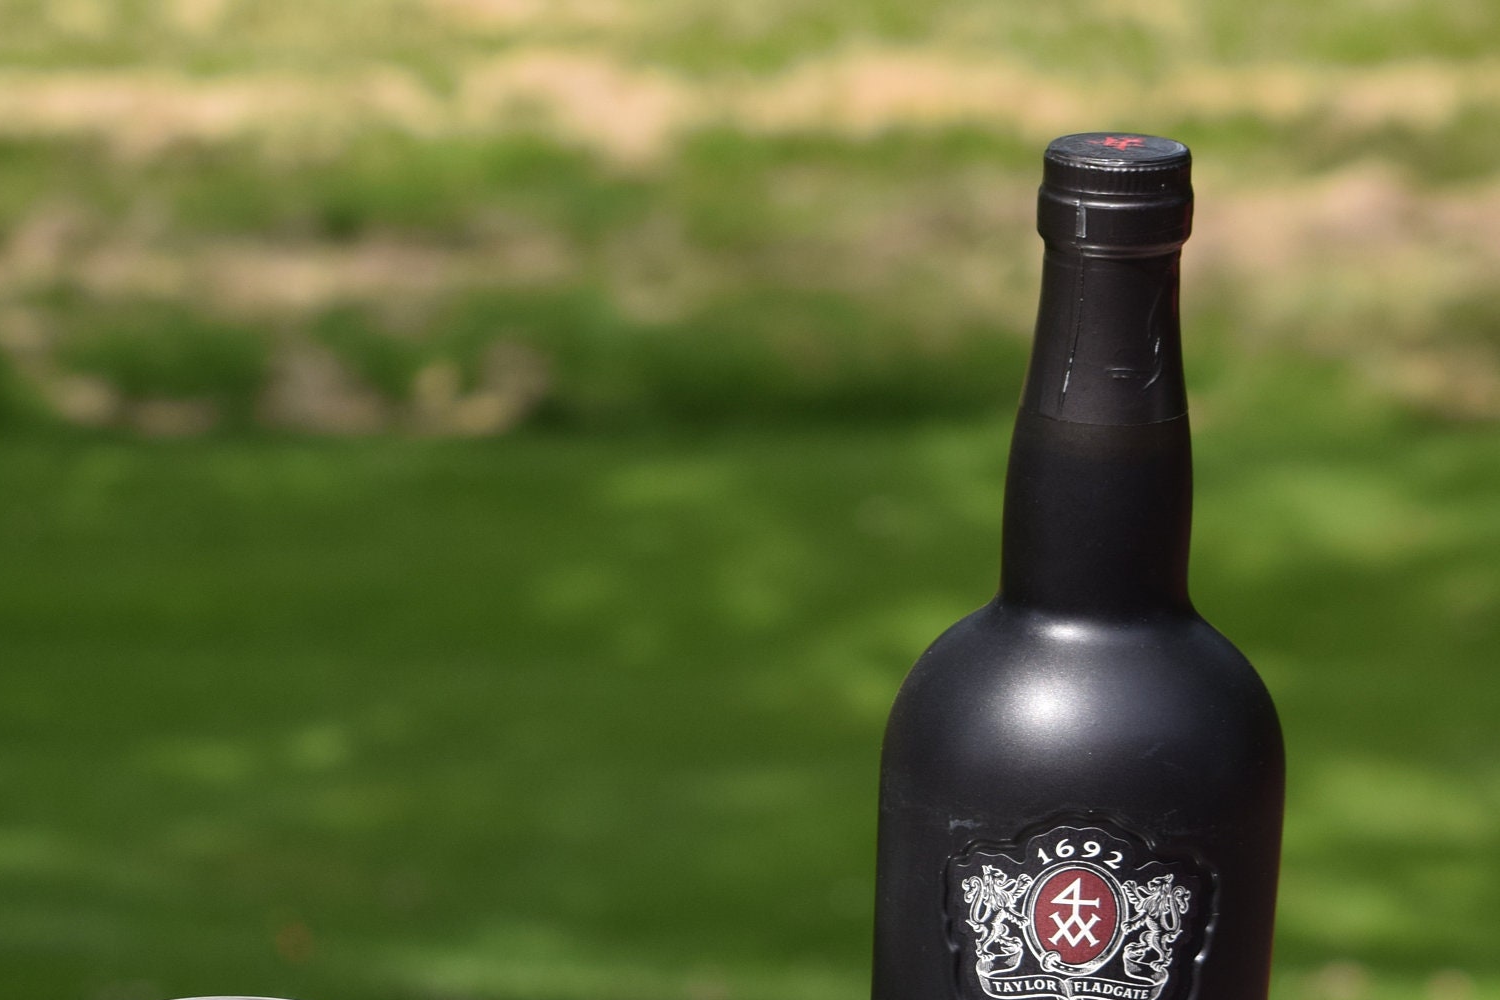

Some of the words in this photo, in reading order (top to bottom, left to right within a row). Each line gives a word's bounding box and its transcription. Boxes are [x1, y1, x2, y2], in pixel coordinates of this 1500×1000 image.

[1037, 839, 1123, 869] 1692
[992, 979, 1057, 993] TAYLOR
[1074, 981, 1149, 1000] FLADGATE
